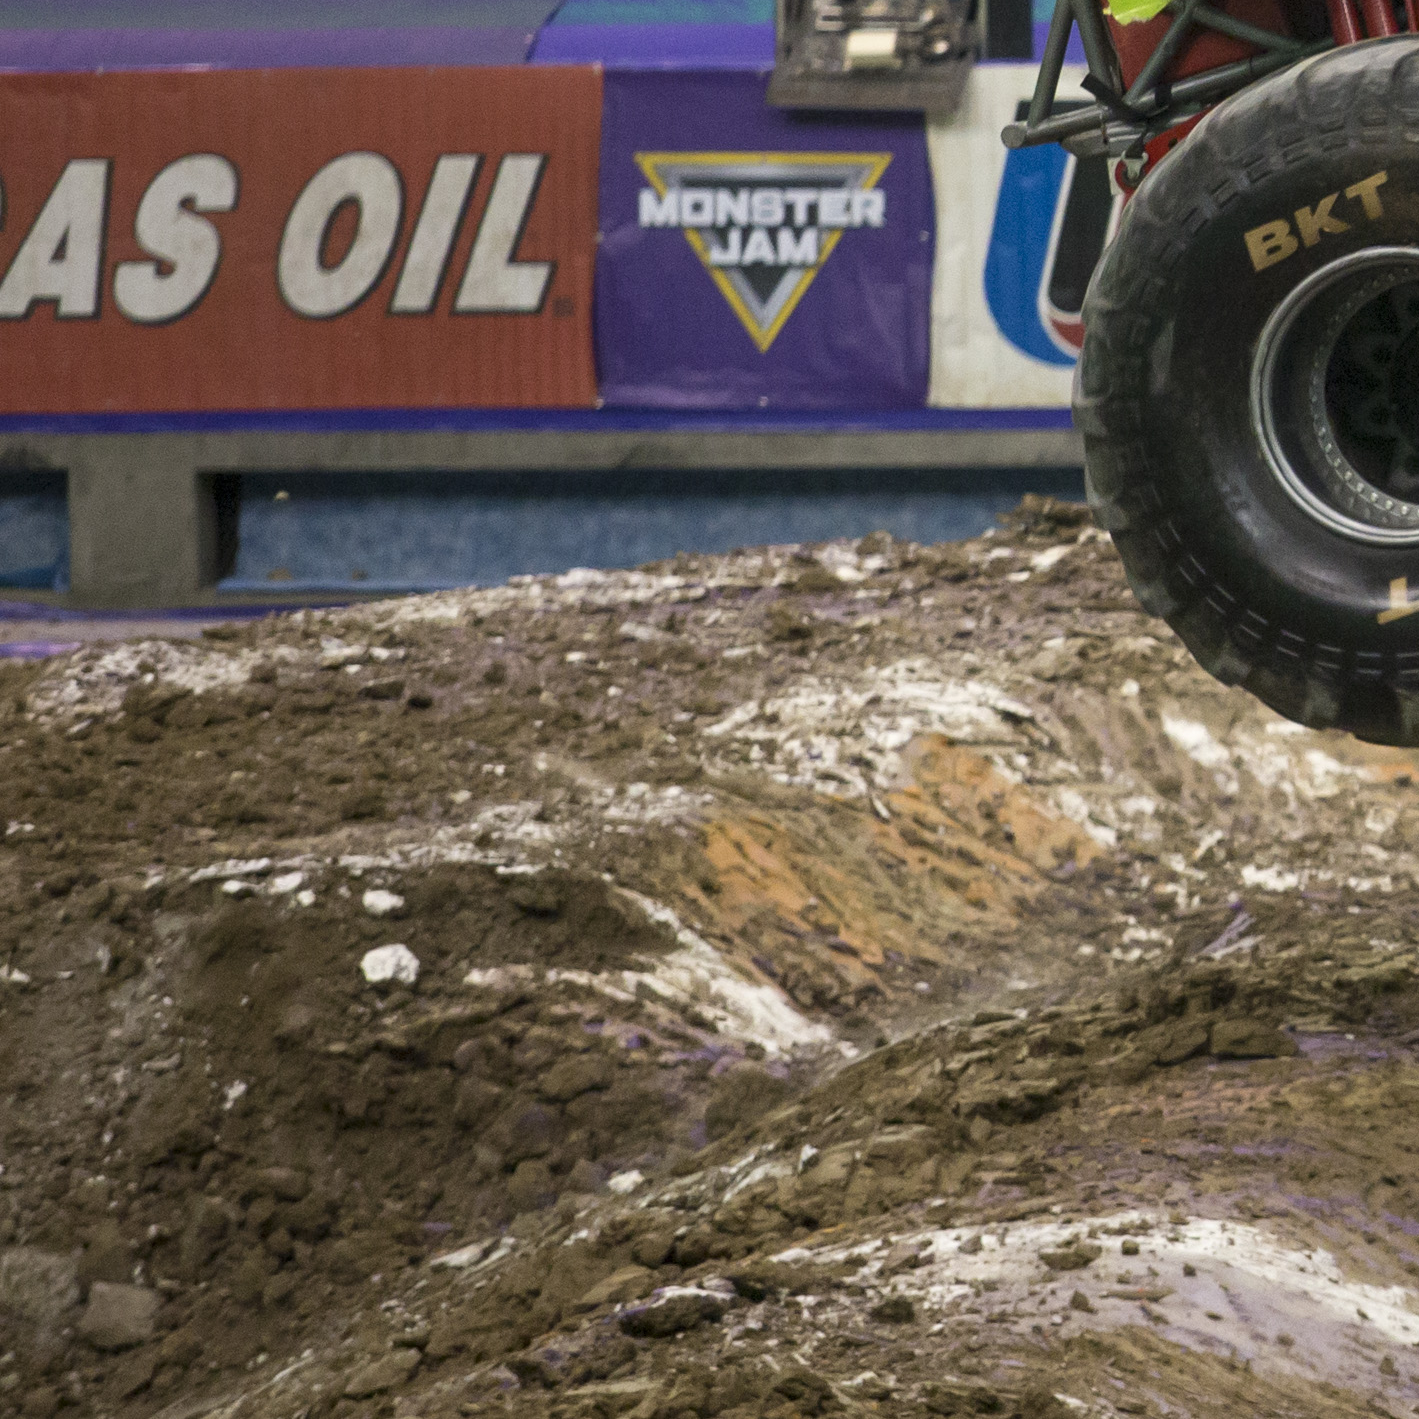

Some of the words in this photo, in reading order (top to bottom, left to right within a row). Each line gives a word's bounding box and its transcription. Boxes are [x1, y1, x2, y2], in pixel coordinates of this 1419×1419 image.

[277, 150, 558, 322] OIL
[638, 186, 887, 228] MONSTER
[1243, 170, 1390, 274] BKT
[708, 225, 819, 267] JAM
